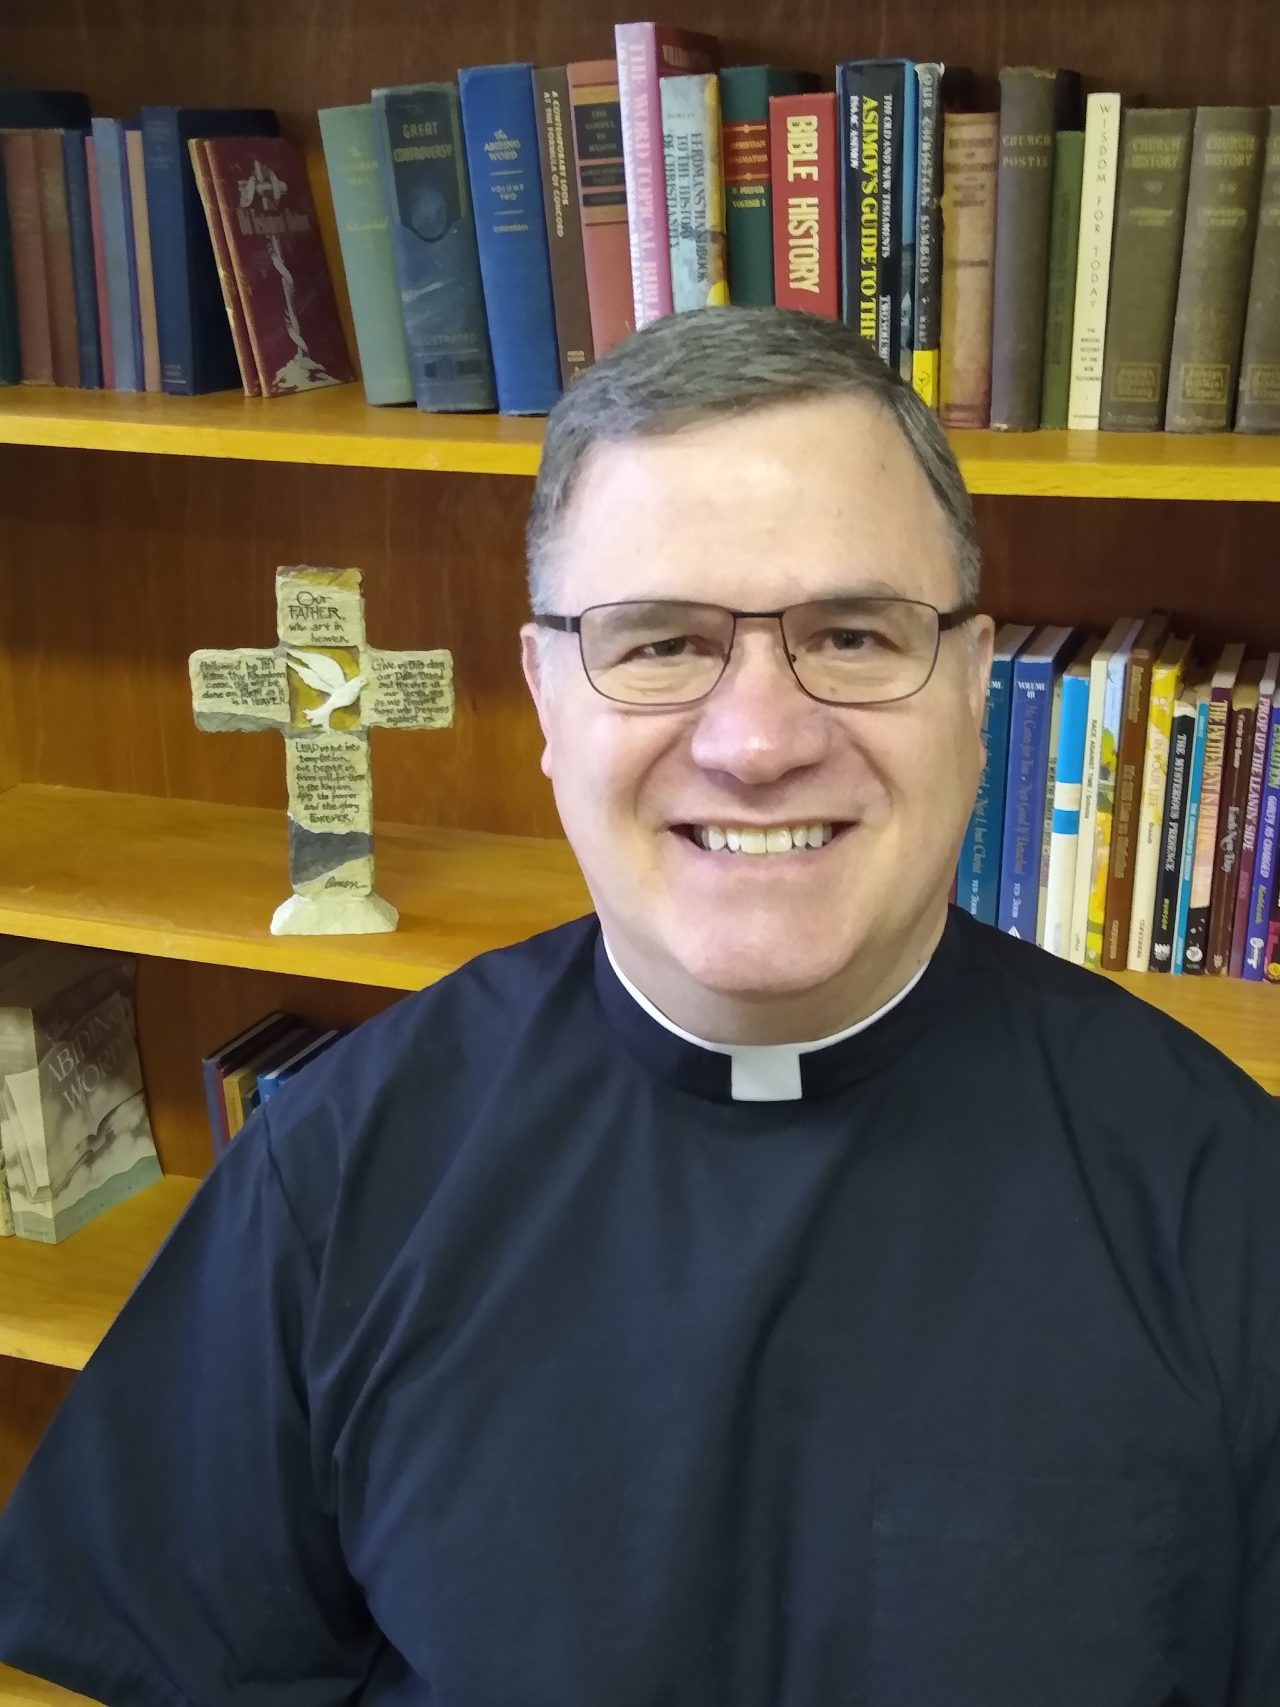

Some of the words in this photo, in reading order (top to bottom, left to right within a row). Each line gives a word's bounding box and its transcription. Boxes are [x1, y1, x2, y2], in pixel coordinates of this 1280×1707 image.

[630, 44, 647, 82] THE
[884, 93, 893, 115] THE
[923, 74, 932, 108] OUR
[403, 121, 438, 139] GREAT
[546, 107, 554, 123] THE
[632, 91, 651, 158] WORD
[883, 116, 892, 140] OLD
[547, 127, 558, 172] FORMULA
[553, 100, 567, 177] CONTEMPORARY
[560, 179, 569, 206] LOOK
[787, 115, 819, 183] BIBLE
[861, 95, 879, 194] ASIMOV'S
[882, 139, 891, 165] AND
[1002, 134, 1051, 147] CHURCH
[1096, 104, 1112, 184] WISDOM
[1131, 137, 1181, 152] CHURCH
[1205, 135, 1255, 151] CHURCH
[920, 117, 933, 206] CHRISTIAN
[1002, 156, 1048, 168] POSTIL
[1130, 154, 1178, 168] HISTORY
[1204, 153, 1254, 167] HISTORY
[551, 174, 559, 187] OF
[882, 165, 891, 191] NEW
[553, 189, 565, 237] CONCORD
[636, 164, 656, 256] TOPICAL
[881, 192, 892, 258] TESTAMENTS
[1094, 197, 1104, 234] FOR
[788, 196, 820, 294] HISTORY
[861, 197, 878, 265] GUIDE
[919, 215, 930, 284] SYMBOLS
[861, 266, 877, 296] TO
[1090, 247, 1101, 309] TODAY
[861, 297, 876, 341] THE
[295, 590, 333, 607] Our
[1018, 681, 1046, 691] VOLUME
[1209, 700, 1228, 722] THE
[1257, 696, 1270, 732] PROP
[1088, 740, 1096, 770] AGAINST
[1176, 733, 1187, 755] THE
[1255, 733, 1266, 750] UP
[1202, 725, 1226, 792] EXCITEMENT
[1251, 752, 1264, 776] THE
[1168, 758, 1185, 820] MYSTERIOUS
[1264, 795, 1278, 825] GUILTY
[1165, 821, 1179, 872] PRESENCE
[1243, 823, 1257, 850] SIDE
[971, 844, 986, 874] Christ
[1259, 838, 1274, 879] CHARGED
